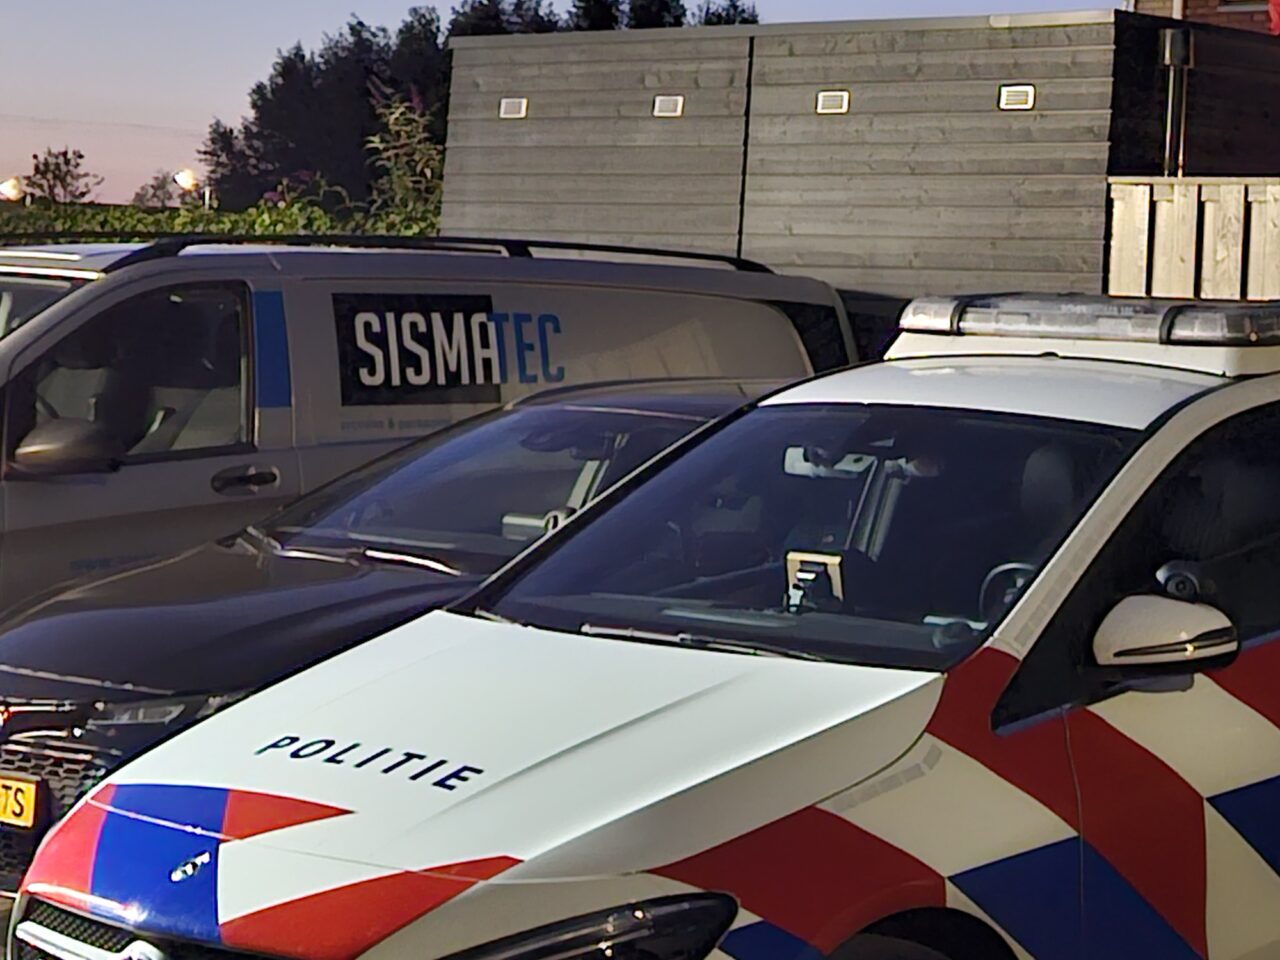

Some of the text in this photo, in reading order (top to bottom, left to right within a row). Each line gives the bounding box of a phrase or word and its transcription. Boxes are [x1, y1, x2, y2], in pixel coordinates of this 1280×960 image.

[353, 311, 565, 387] SISMATEC
[254, 735, 485, 792] POLITIE
[1, 783, 25, 818] TS
